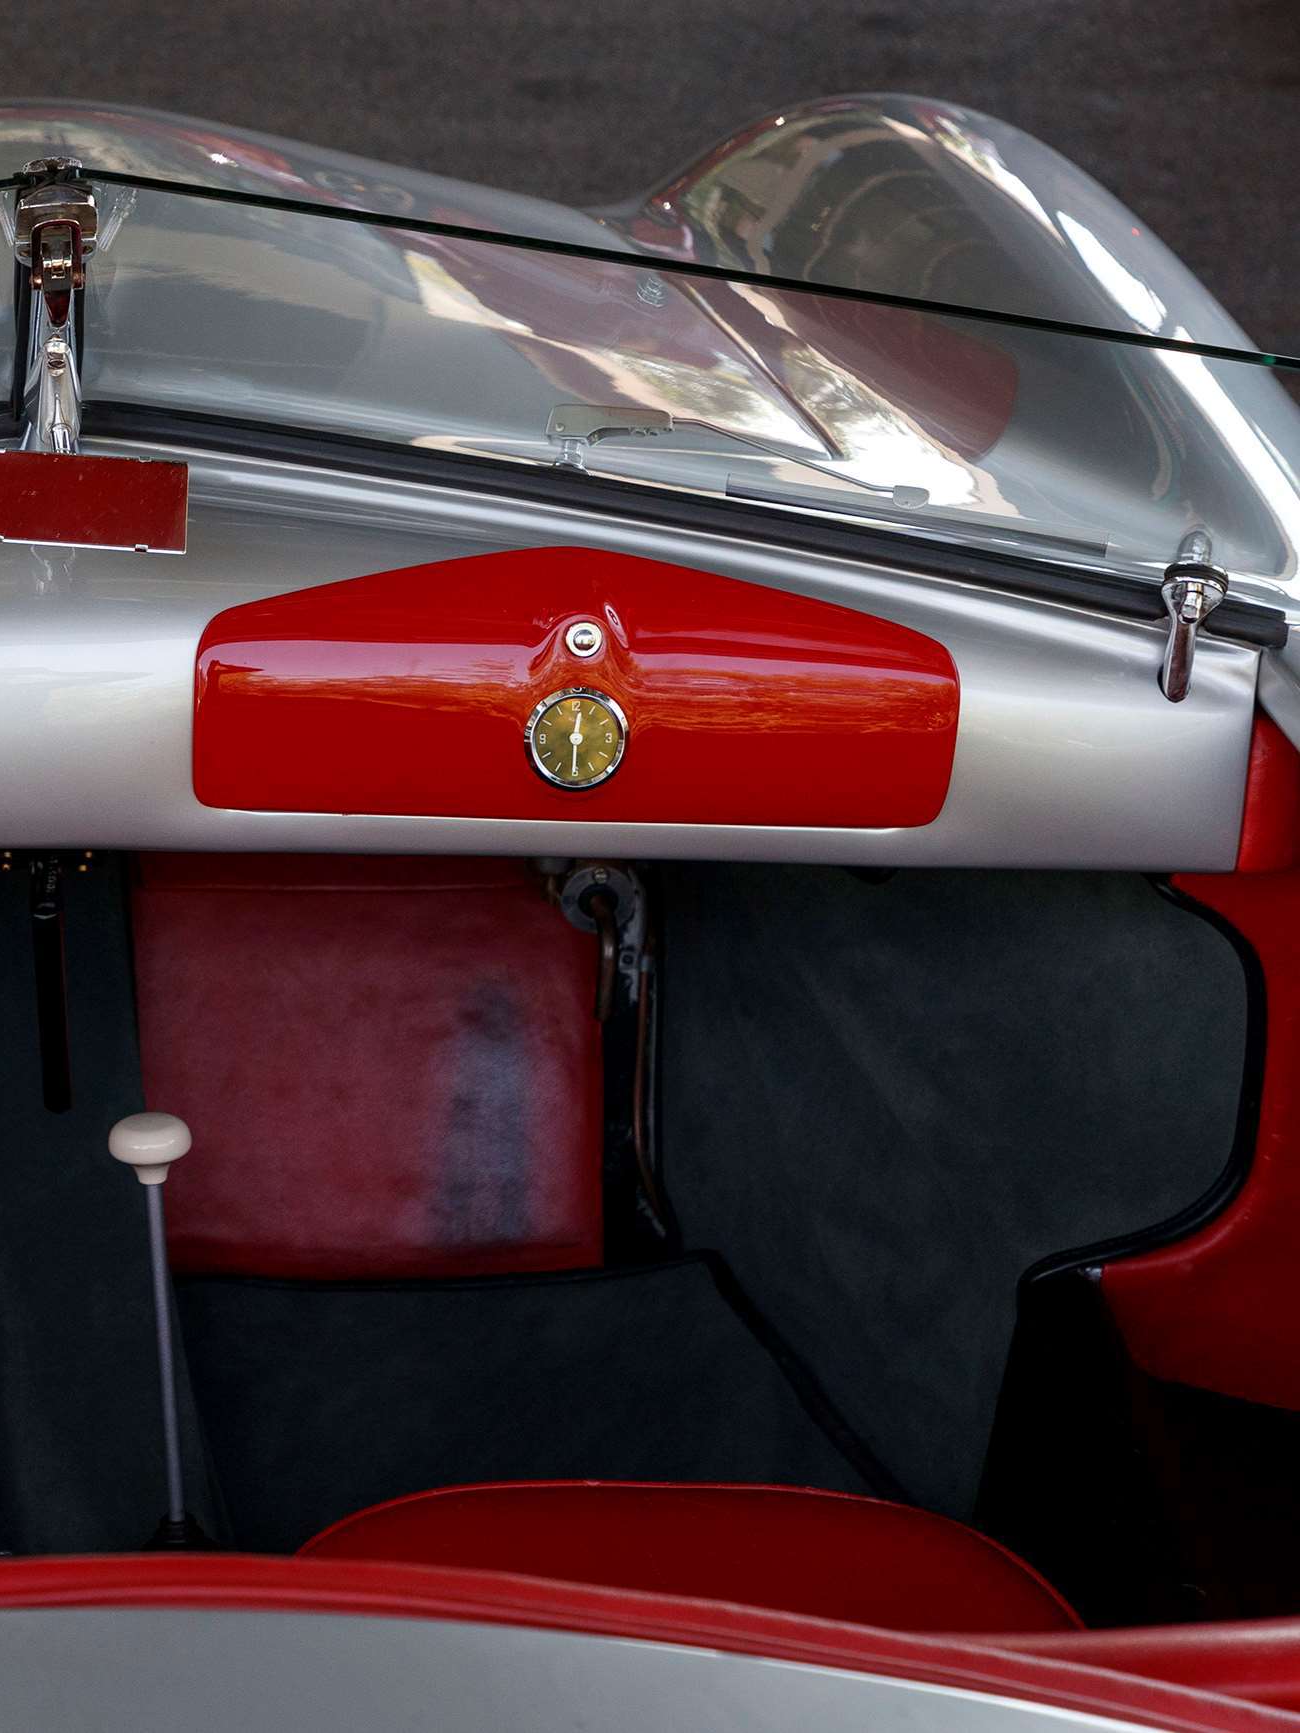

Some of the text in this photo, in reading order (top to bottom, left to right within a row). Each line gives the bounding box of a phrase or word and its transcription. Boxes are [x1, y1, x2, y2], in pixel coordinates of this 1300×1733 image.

[572, 700, 581, 711] 12
[539, 734, 546, 744] 9
[605, 733, 613, 743] 3
